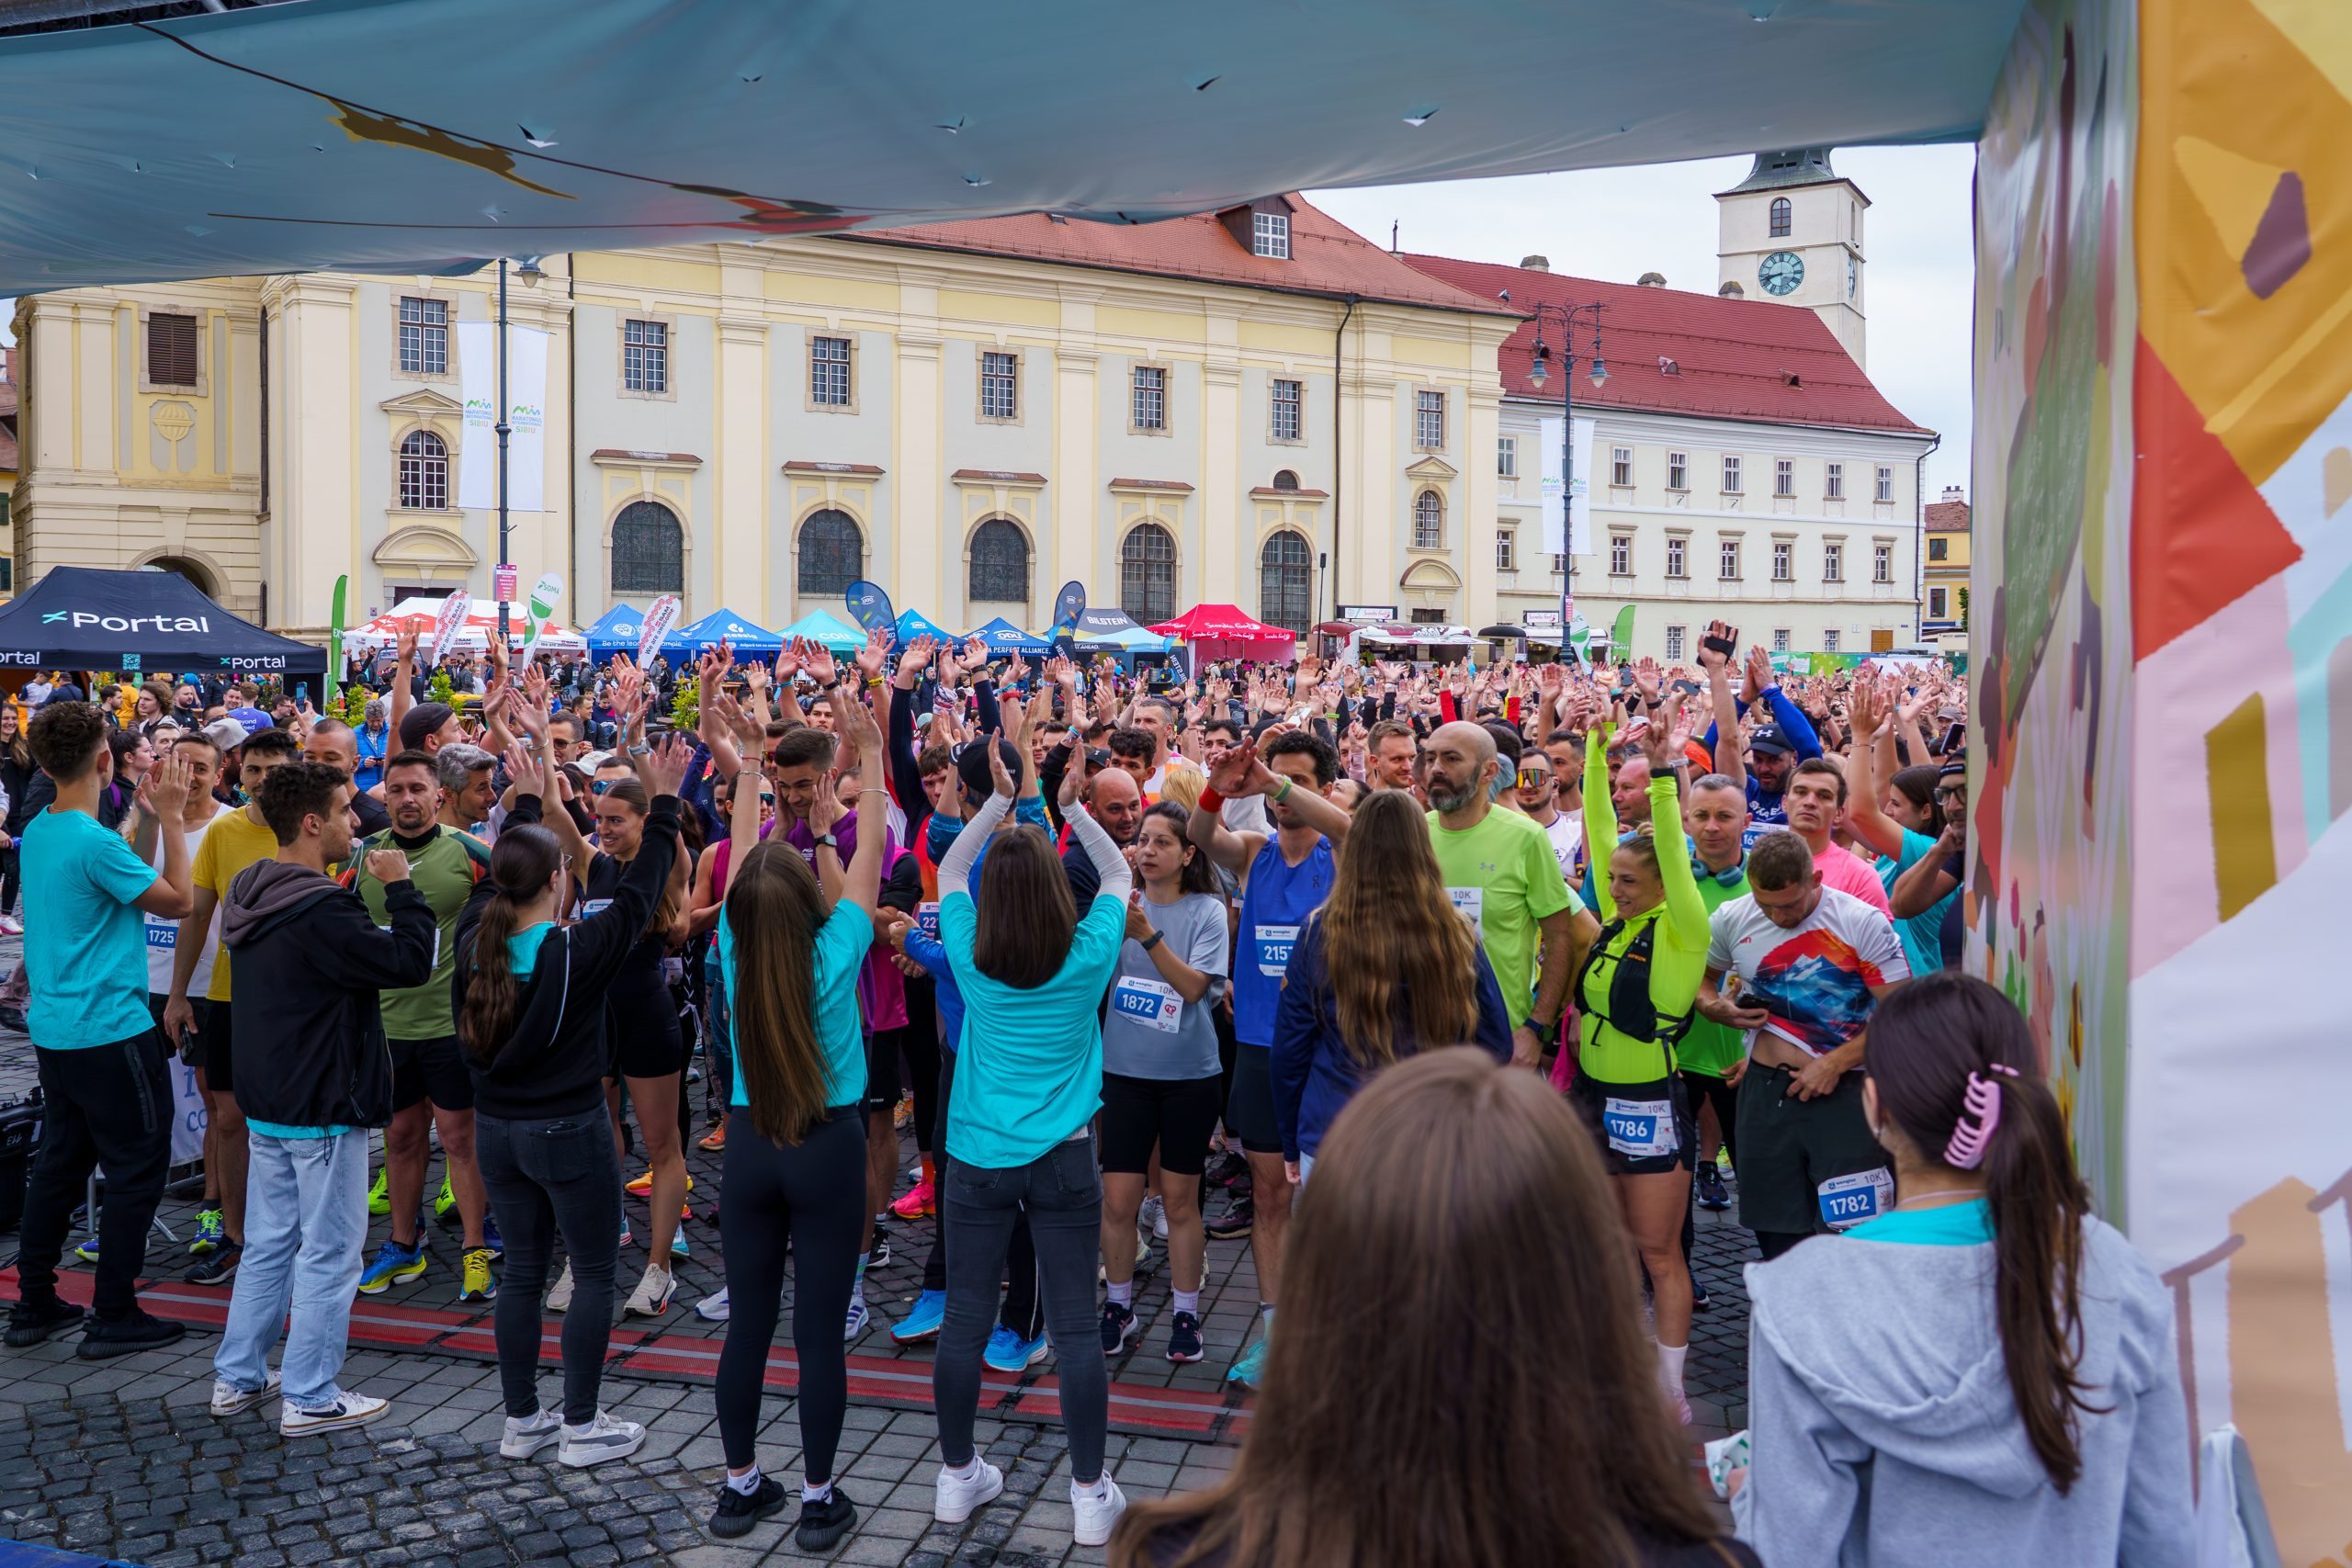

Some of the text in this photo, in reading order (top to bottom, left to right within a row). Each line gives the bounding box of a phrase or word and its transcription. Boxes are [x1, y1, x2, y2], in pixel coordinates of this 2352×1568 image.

[544, 584, 560, 594] SOMA
[73, 612, 210, 633] Portal
[1086, 615, 1128, 626] BILSTEIN
[438, 643, 447, 653] We
[450, 604, 467, 633] awesome
[645, 608, 675, 655] We are awesome
[0, 651, 40, 666] ortal
[232, 655, 286, 670] Portal
[1453, 891, 1472, 899] 10K
[922, 917, 939, 929] 22
[149, 929, 175, 944] 1725
[1159, 986, 1175, 996] 10K
[1122, 993, 1155, 1014] 1872
[1647, 1104, 1667, 1114] 10K
[1610, 1119, 1648, 1138] 1786
[1863, 1171, 1883, 1184] 10K
[1829, 1193, 1871, 1215] 1782
